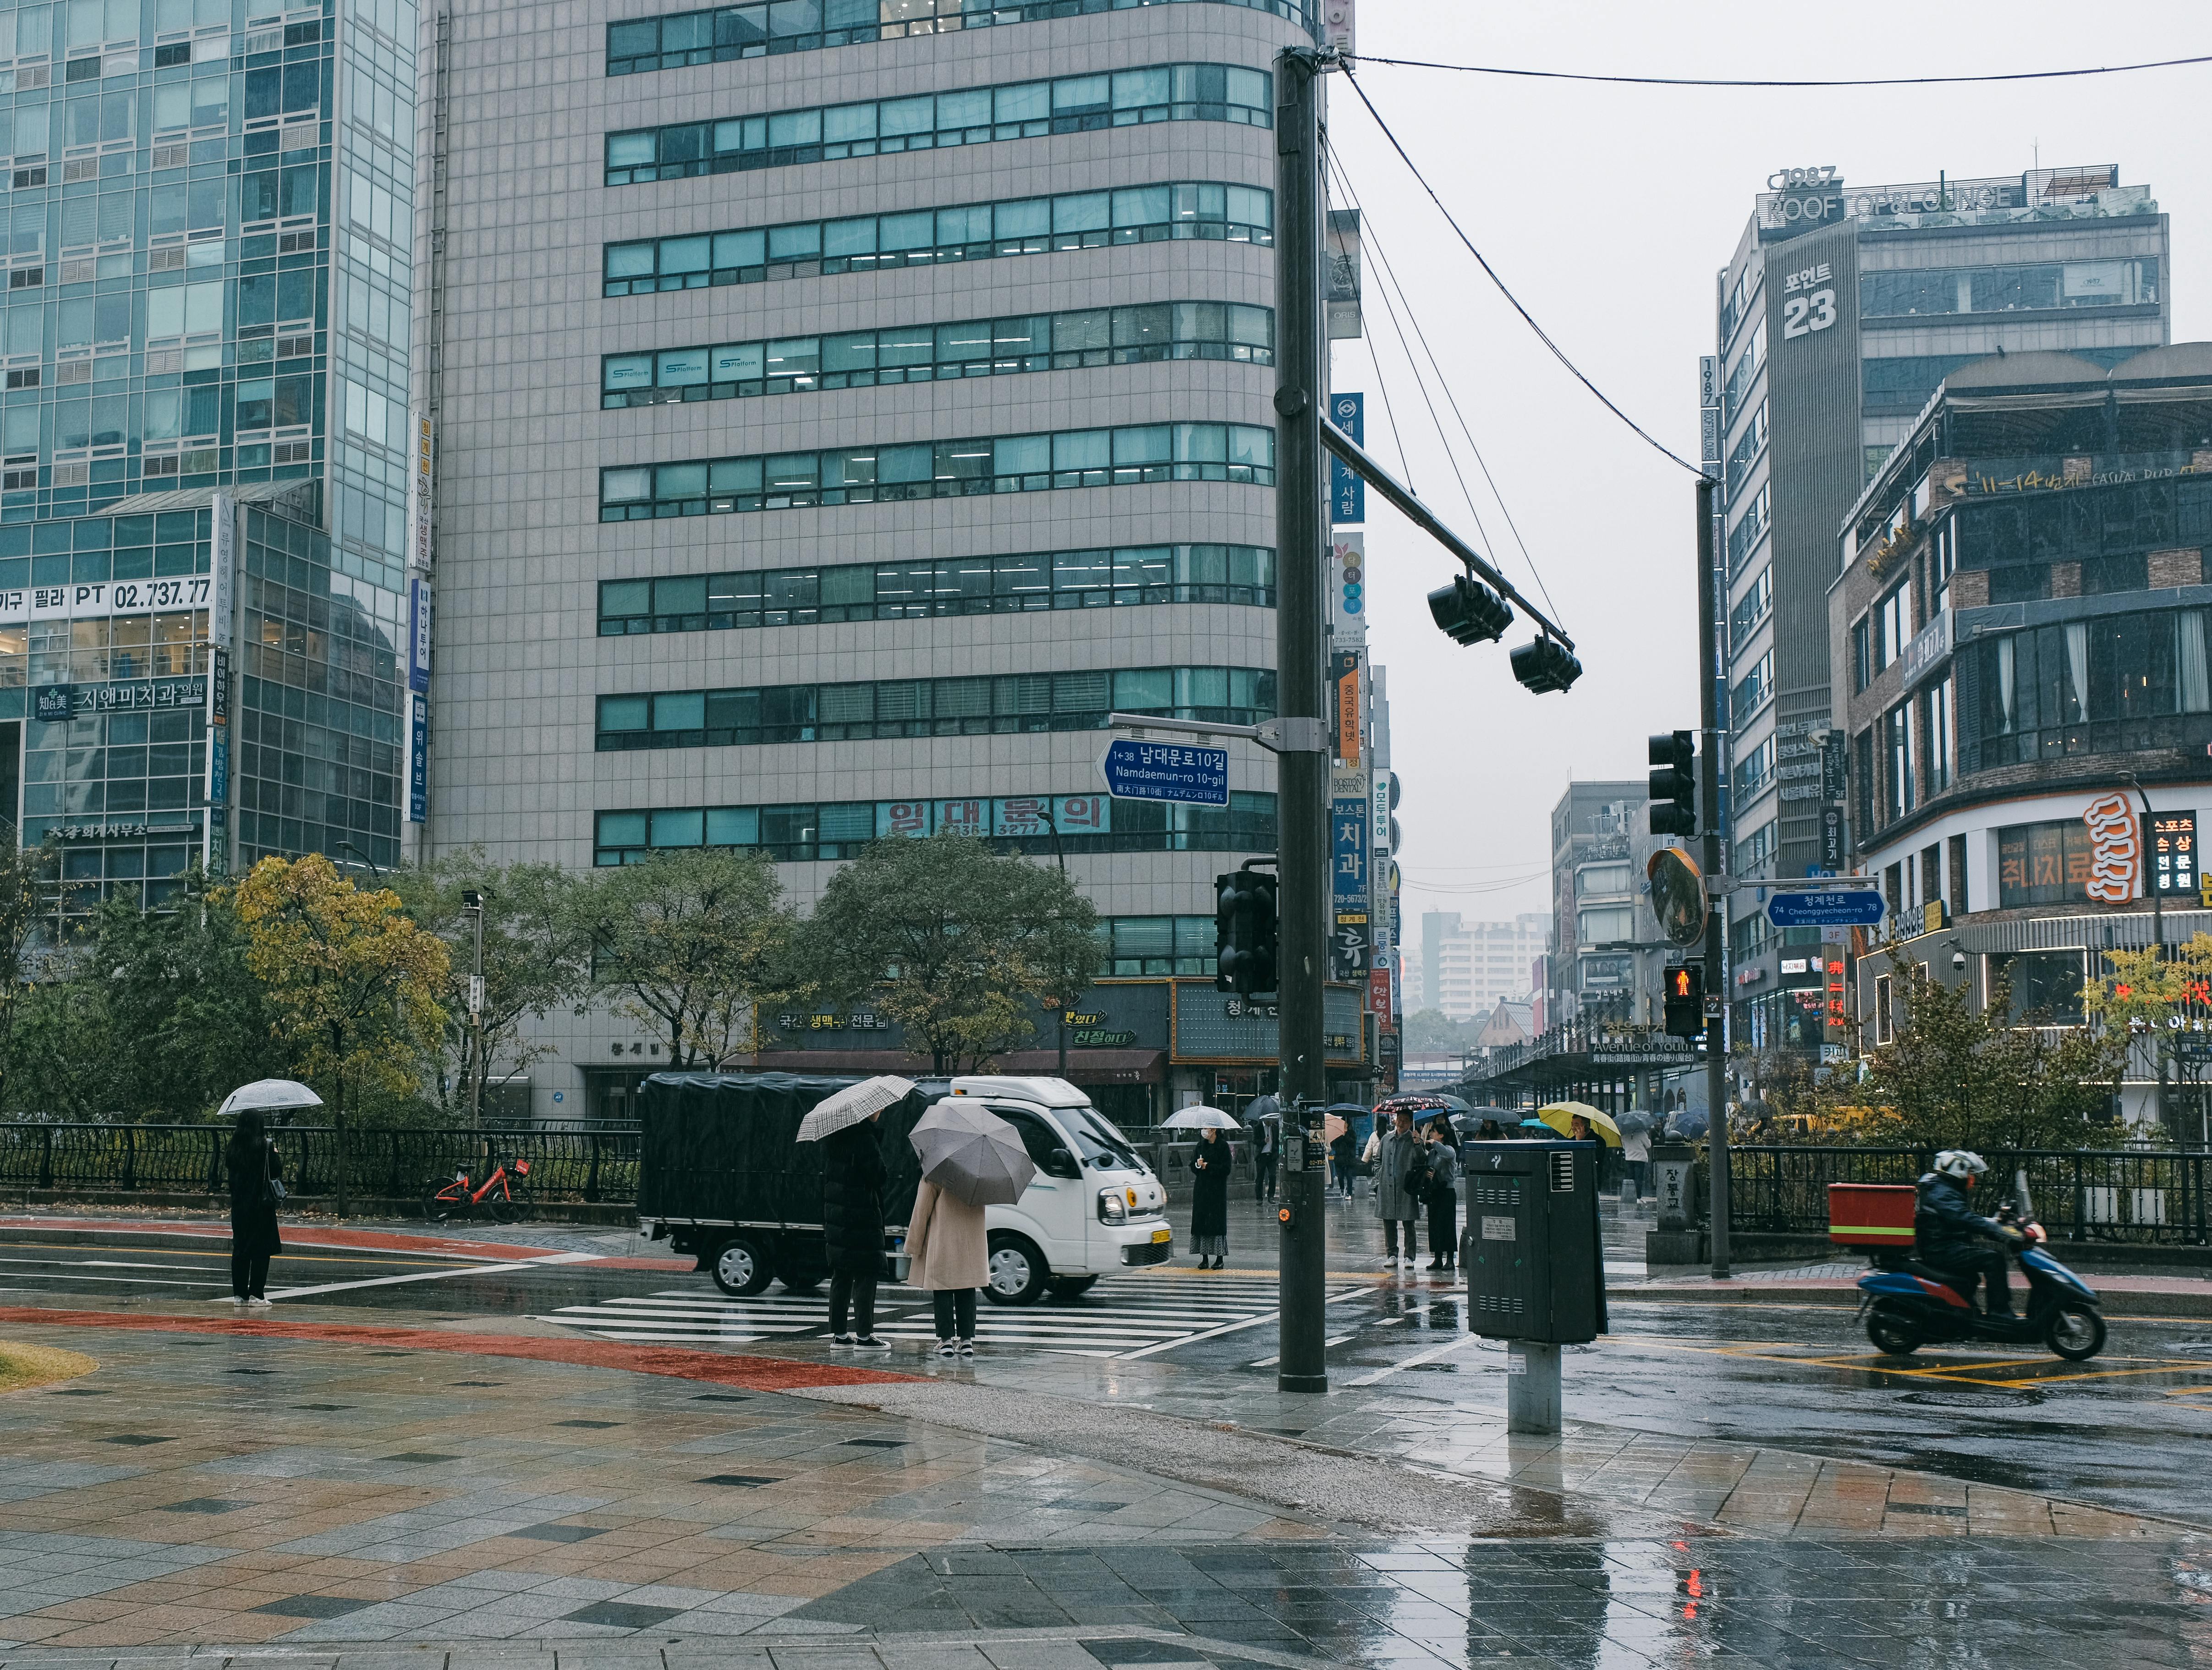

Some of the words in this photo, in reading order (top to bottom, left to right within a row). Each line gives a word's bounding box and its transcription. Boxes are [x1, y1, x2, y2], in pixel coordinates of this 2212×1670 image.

[1785, 263, 1833, 293] 포인트
[1334, 311, 1356, 320] ORIS
[1784, 289, 1835, 340] 23
[1703, 359, 1713, 405] 1987
[1341, 486, 1355, 515] 사람
[420, 516, 428, 525] 국산
[1347, 555, 1356, 610] 닥터포유
[35, 588, 65, 608] 필라
[76, 585, 105, 605] PT
[216, 655, 225, 715] 비어하우스
[81, 683, 178, 711] 지앤미치과
[181, 683, 203, 696] 의원
[1344, 685, 1354, 742] 중국유학넷
[415, 730, 423, 786] 위솔브
[1125, 752, 1134, 761] 38
[1141, 746, 1224, 771] 남대문로10길
[214, 745, 224, 797] 김밥천국
[1116, 766, 1193, 783] Namdaemun-ro
[1197, 773, 1224, 787] 10-gil
[1117, 785, 1162, 796] 南大门路10街
[1334, 778, 1362, 786] BOSTON
[1334, 784, 1361, 793] DENTAL
[1167, 789, 1224, 801] ナムデムンロ10ギル
[1334, 805, 1365, 818] 보스톤
[1376, 793, 1387, 837] 모두투어
[998, 823, 1039, 835] 3277
[2155, 819, 2193, 832] 스포츠
[1338, 823, 1363, 880] 치과
[1828, 826, 1836, 860] 최고기
[2003, 852, 2092, 889] 추나치료
[2158, 855, 2191, 871] 전문
[2158, 872, 2191, 889] 병원
[1334, 894, 1367, 903] 720-5673/2
[1804, 895, 1846, 906] 청계천로
[1337, 927, 1368, 967] 휴
[1074, 1030, 1126, 1043] 친절하다
[1606, 1019, 1648, 1037] 젊음의
[1323, 1035, 1332, 1047] 국산
[1334, 1036, 1345, 1047] 생맥주
[1593, 1041, 1641, 1052] Avenue
[1642, 1042, 1655, 1052] of
[1667, 1169, 1679, 1209] 장통교
